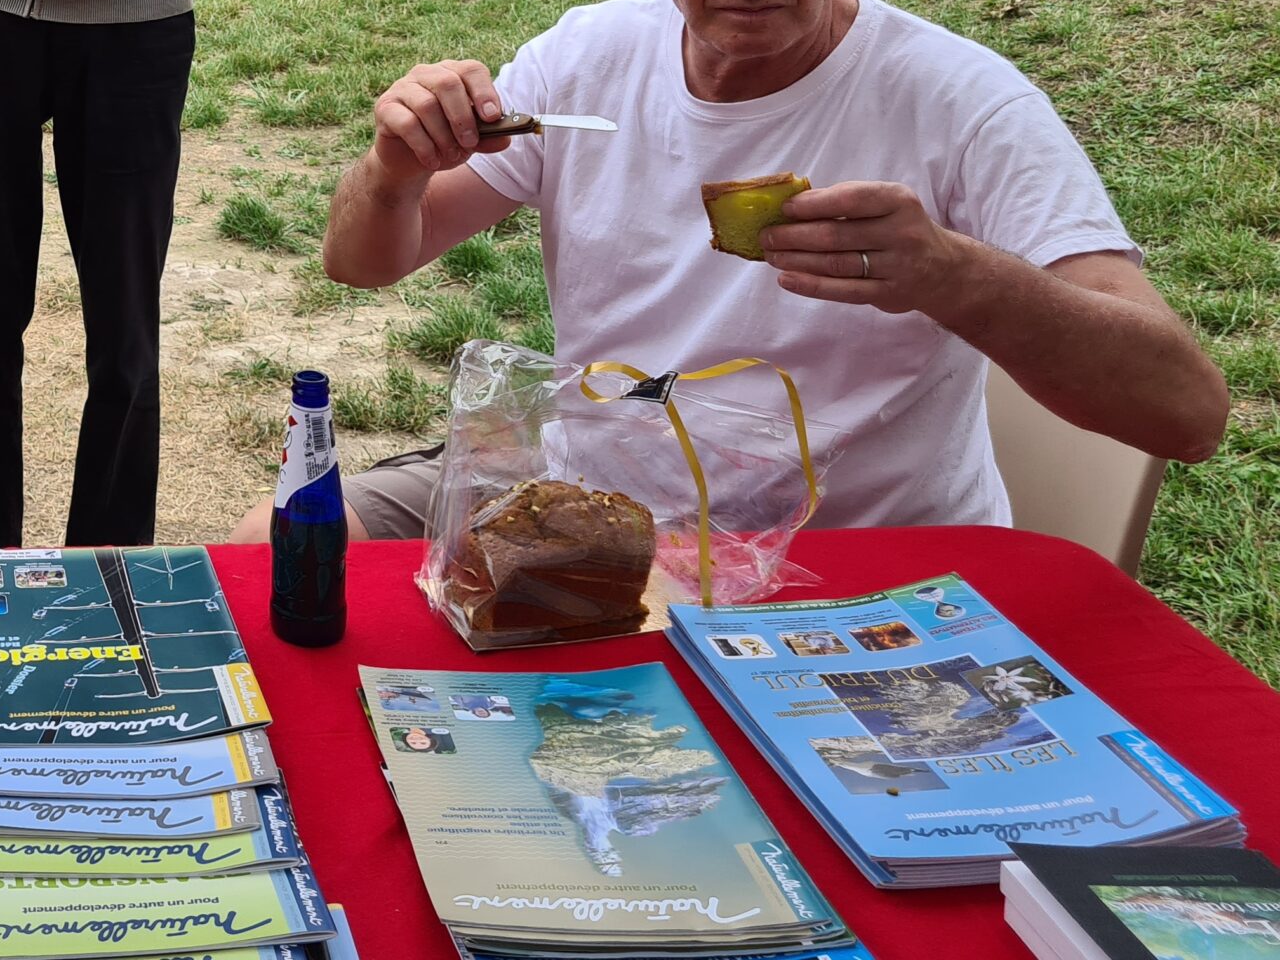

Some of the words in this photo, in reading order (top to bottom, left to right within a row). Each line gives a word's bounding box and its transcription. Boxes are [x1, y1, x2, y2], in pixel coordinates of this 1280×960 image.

[5, 665, 36, 694] Dossier
[751, 670, 881, 690] FRIOUL
[886, 664, 940, 686] DU
[8, 709, 96, 719] développement
[97, 709, 128, 717] autre
[148, 704, 176, 714] Pour
[244, 731, 264, 776] aturellement
[1010, 741, 1078, 768] LES
[2, 757, 94, 767] développement
[96, 758, 129, 766] autre
[148, 756, 177, 764] Pour
[1041, 800, 1061, 811] un
[1062, 794, 1095, 808] Pour
[905, 806, 1005, 821] développement
[1006, 803, 1040, 814] autre
[884, 807, 1158, 843] Naturellement
[495, 882, 601, 893] développement
[604, 884, 641, 892] autre
[643, 884, 661, 892] un
[663, 883, 697, 892] Pour
[128, 900, 165, 910] autre
[167, 899, 184, 908] un
[187, 896, 220, 908] Pour
[22, 902, 126, 915] développement
[453, 894, 761, 923] Naturellement
